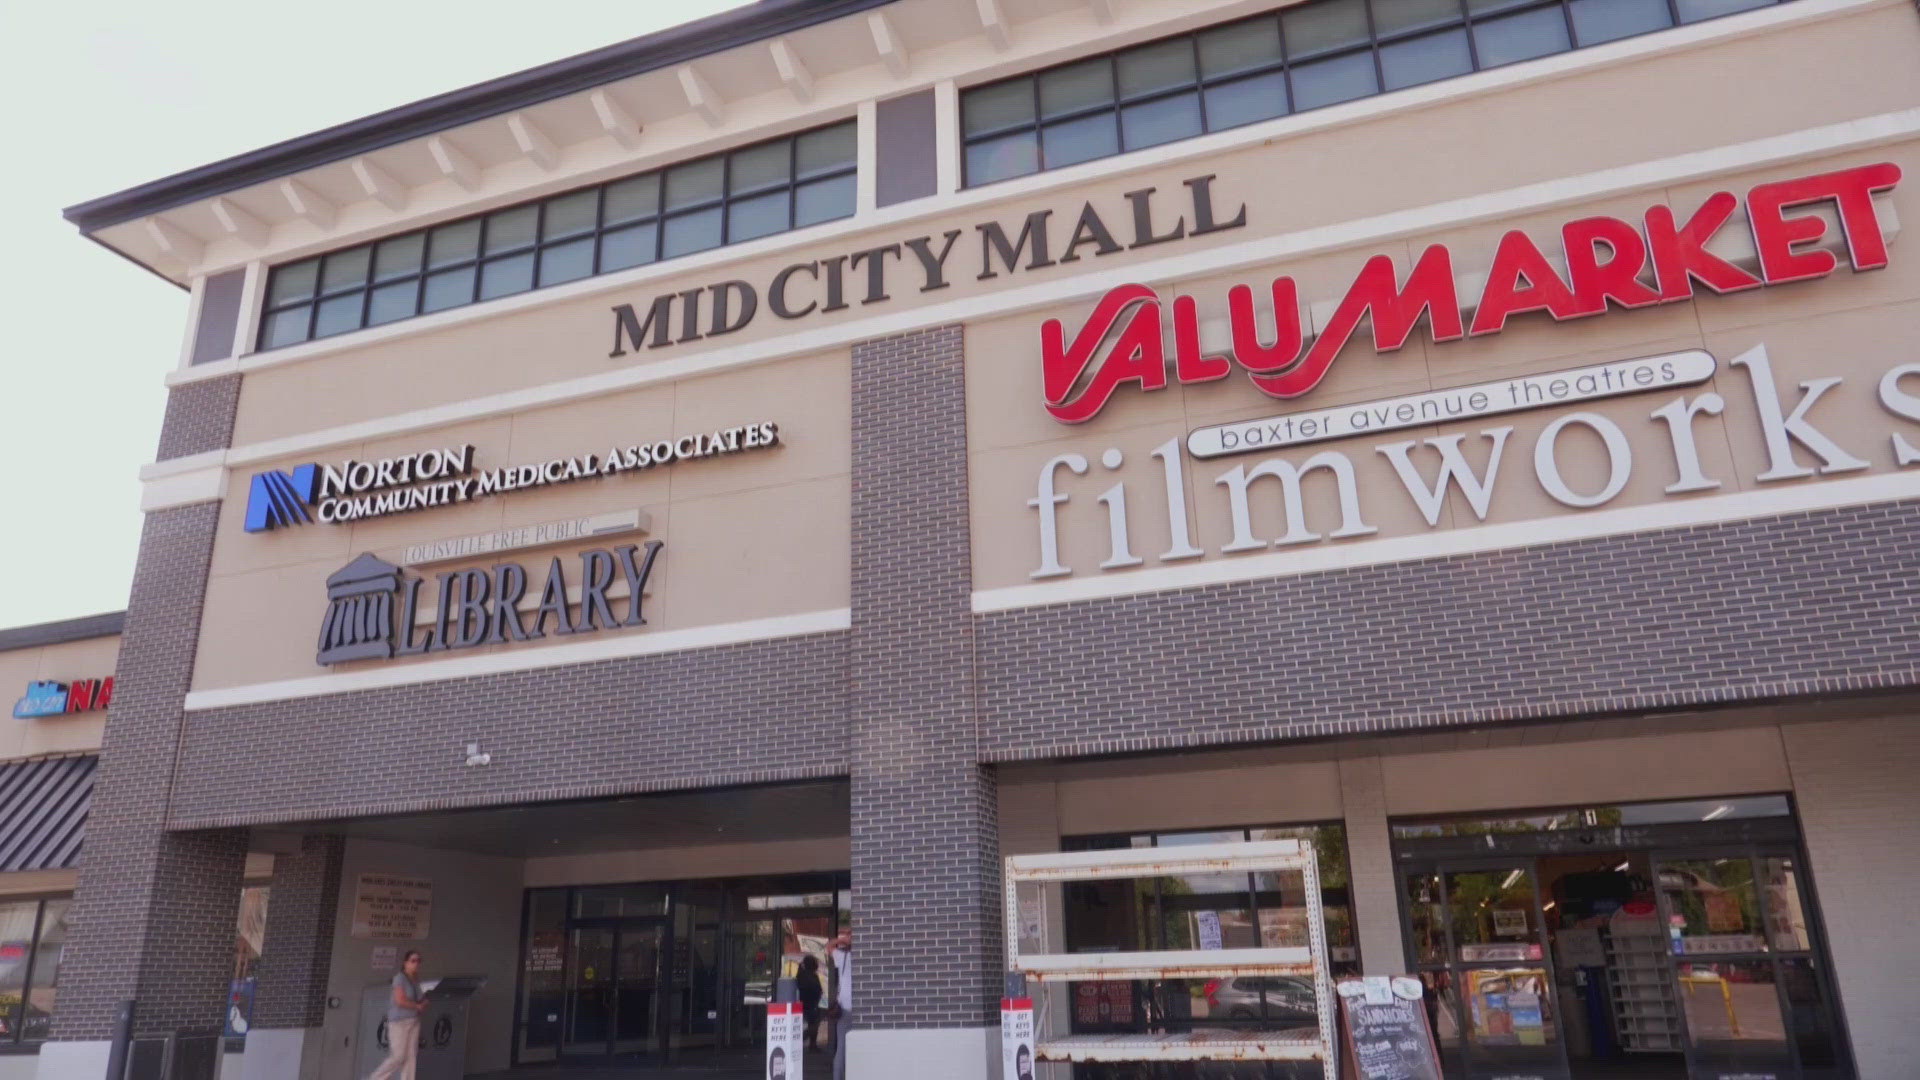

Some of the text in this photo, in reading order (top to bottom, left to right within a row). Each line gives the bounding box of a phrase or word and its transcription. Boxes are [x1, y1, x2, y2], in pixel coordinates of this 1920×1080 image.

[608, 173, 1247, 357] MID CITY MALL
[1219, 360, 1676, 450] baxter avenue theatres
[318, 421, 777, 524] COMMUNITY MEDICAL ASSOCIATES
[319, 445, 474, 498] NORTON
[403, 517, 590, 564] LOUISVILLE FREE PUBLIC
[397, 540, 664, 655] LIBRARY
